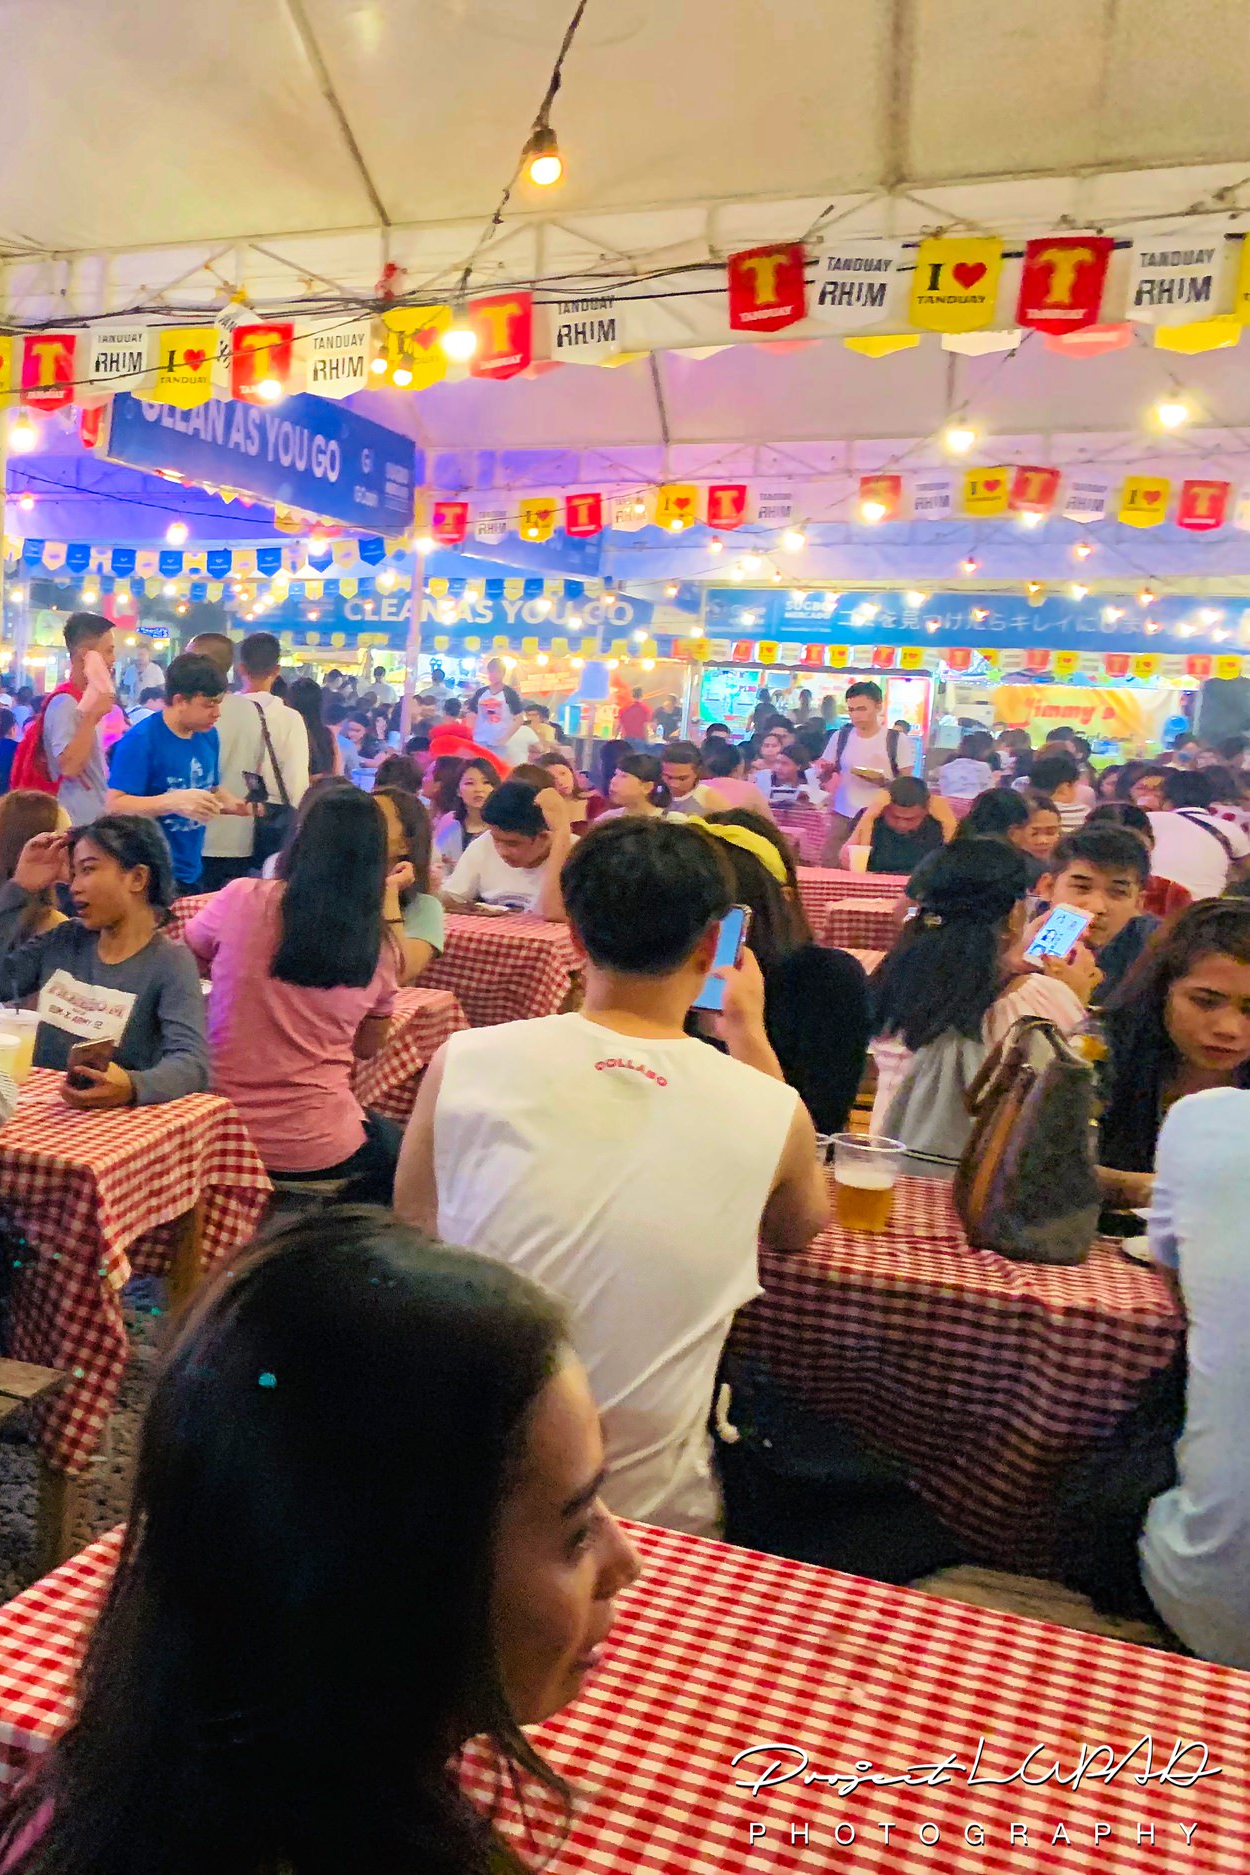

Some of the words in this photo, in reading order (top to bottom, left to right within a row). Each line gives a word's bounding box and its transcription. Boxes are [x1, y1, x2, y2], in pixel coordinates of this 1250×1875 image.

[827, 256, 893, 272] TANDUAY
[927, 263, 945, 290] I
[917, 295, 986, 305] TANDUAY
[313, 333, 365, 351] TANDUAY
[166, 350, 177, 373] I
[228, 407, 261, 457] AS
[265, 413, 309, 472] YOU
[311, 434, 341, 483] GO
[502, 600, 574, 624] YOU
